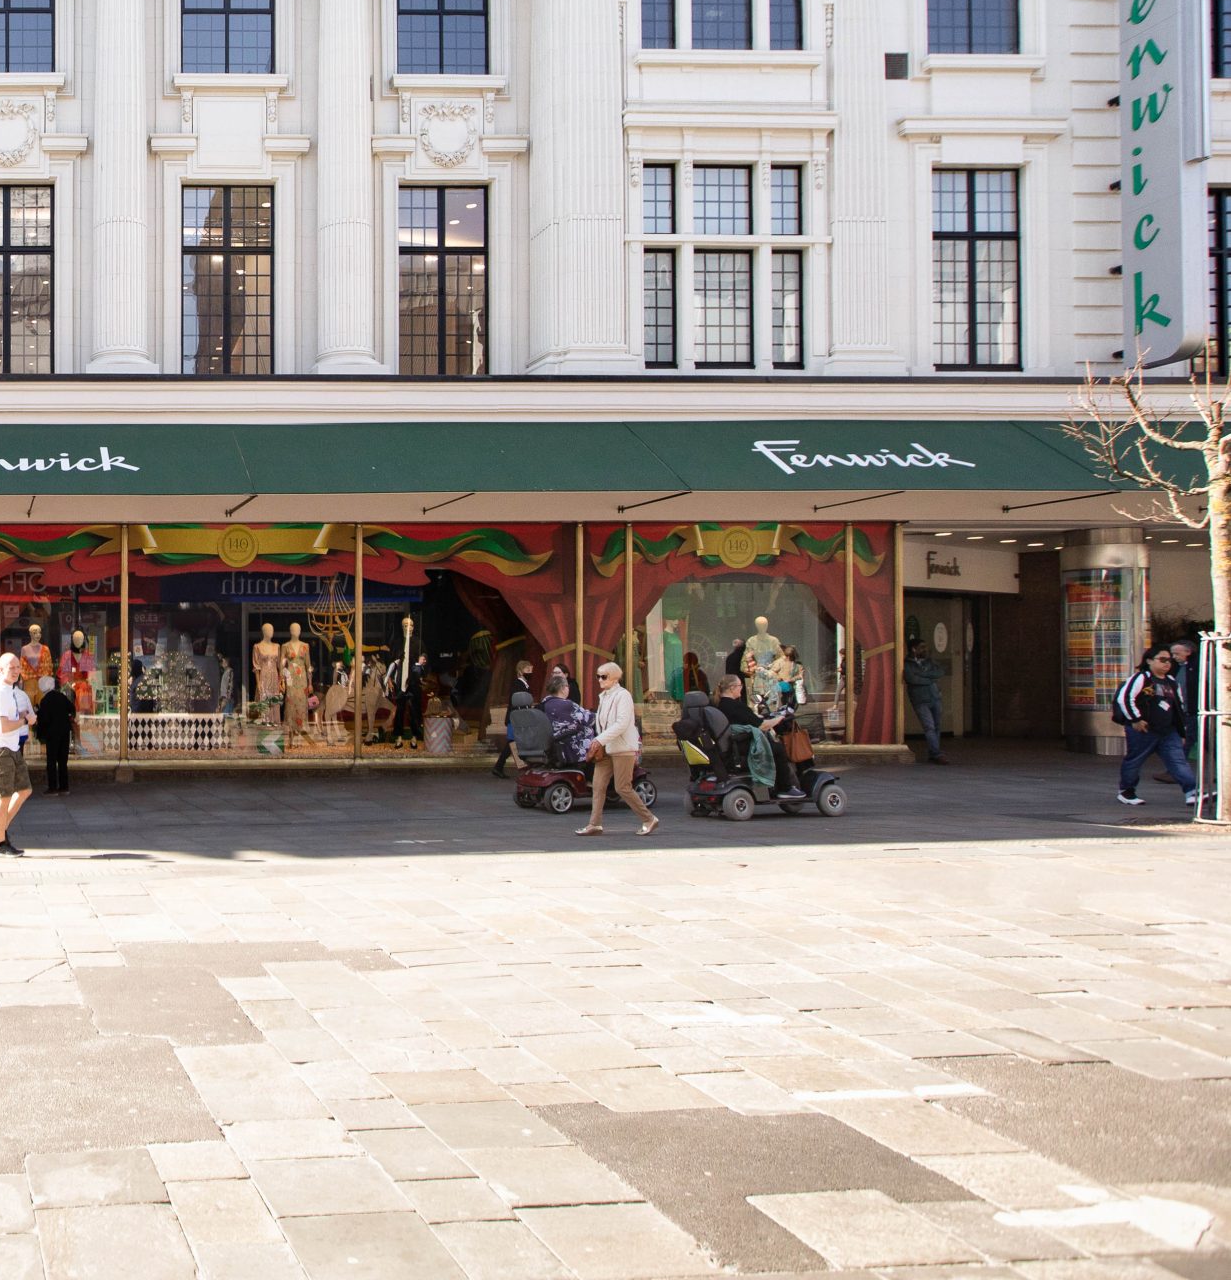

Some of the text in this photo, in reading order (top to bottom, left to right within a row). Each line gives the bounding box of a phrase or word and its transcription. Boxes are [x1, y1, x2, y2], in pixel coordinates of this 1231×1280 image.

[752, 439, 976, 475] Fenwick
[228, 538, 249, 550] 140
[728, 539, 749, 552] 140
